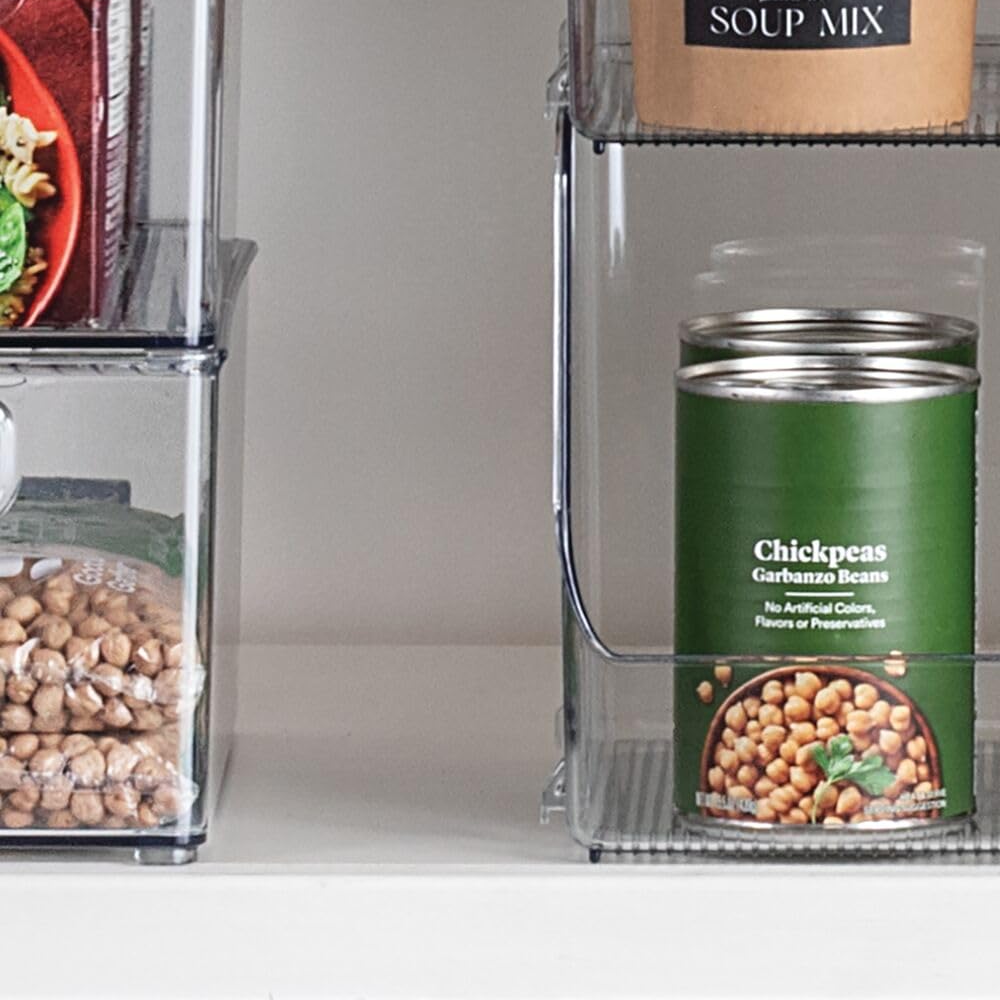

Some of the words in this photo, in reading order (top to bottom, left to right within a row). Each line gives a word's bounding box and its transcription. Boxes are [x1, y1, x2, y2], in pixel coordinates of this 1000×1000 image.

[710, 5, 805, 38] SOUP
[819, 5, 884, 38] MIX
[753, 538, 888, 569] Chickpeas
[752, 567, 836, 584] Garbanzo
[837, 569, 890, 585] Beans
[764, 601, 782, 613] No
[783, 602, 833, 614] Artificial
[834, 602, 876, 615] Colors,
[755, 616, 794, 629] Flavors
[796, 619, 809, 628] or
[810, 616, 886, 630] Preservatives
